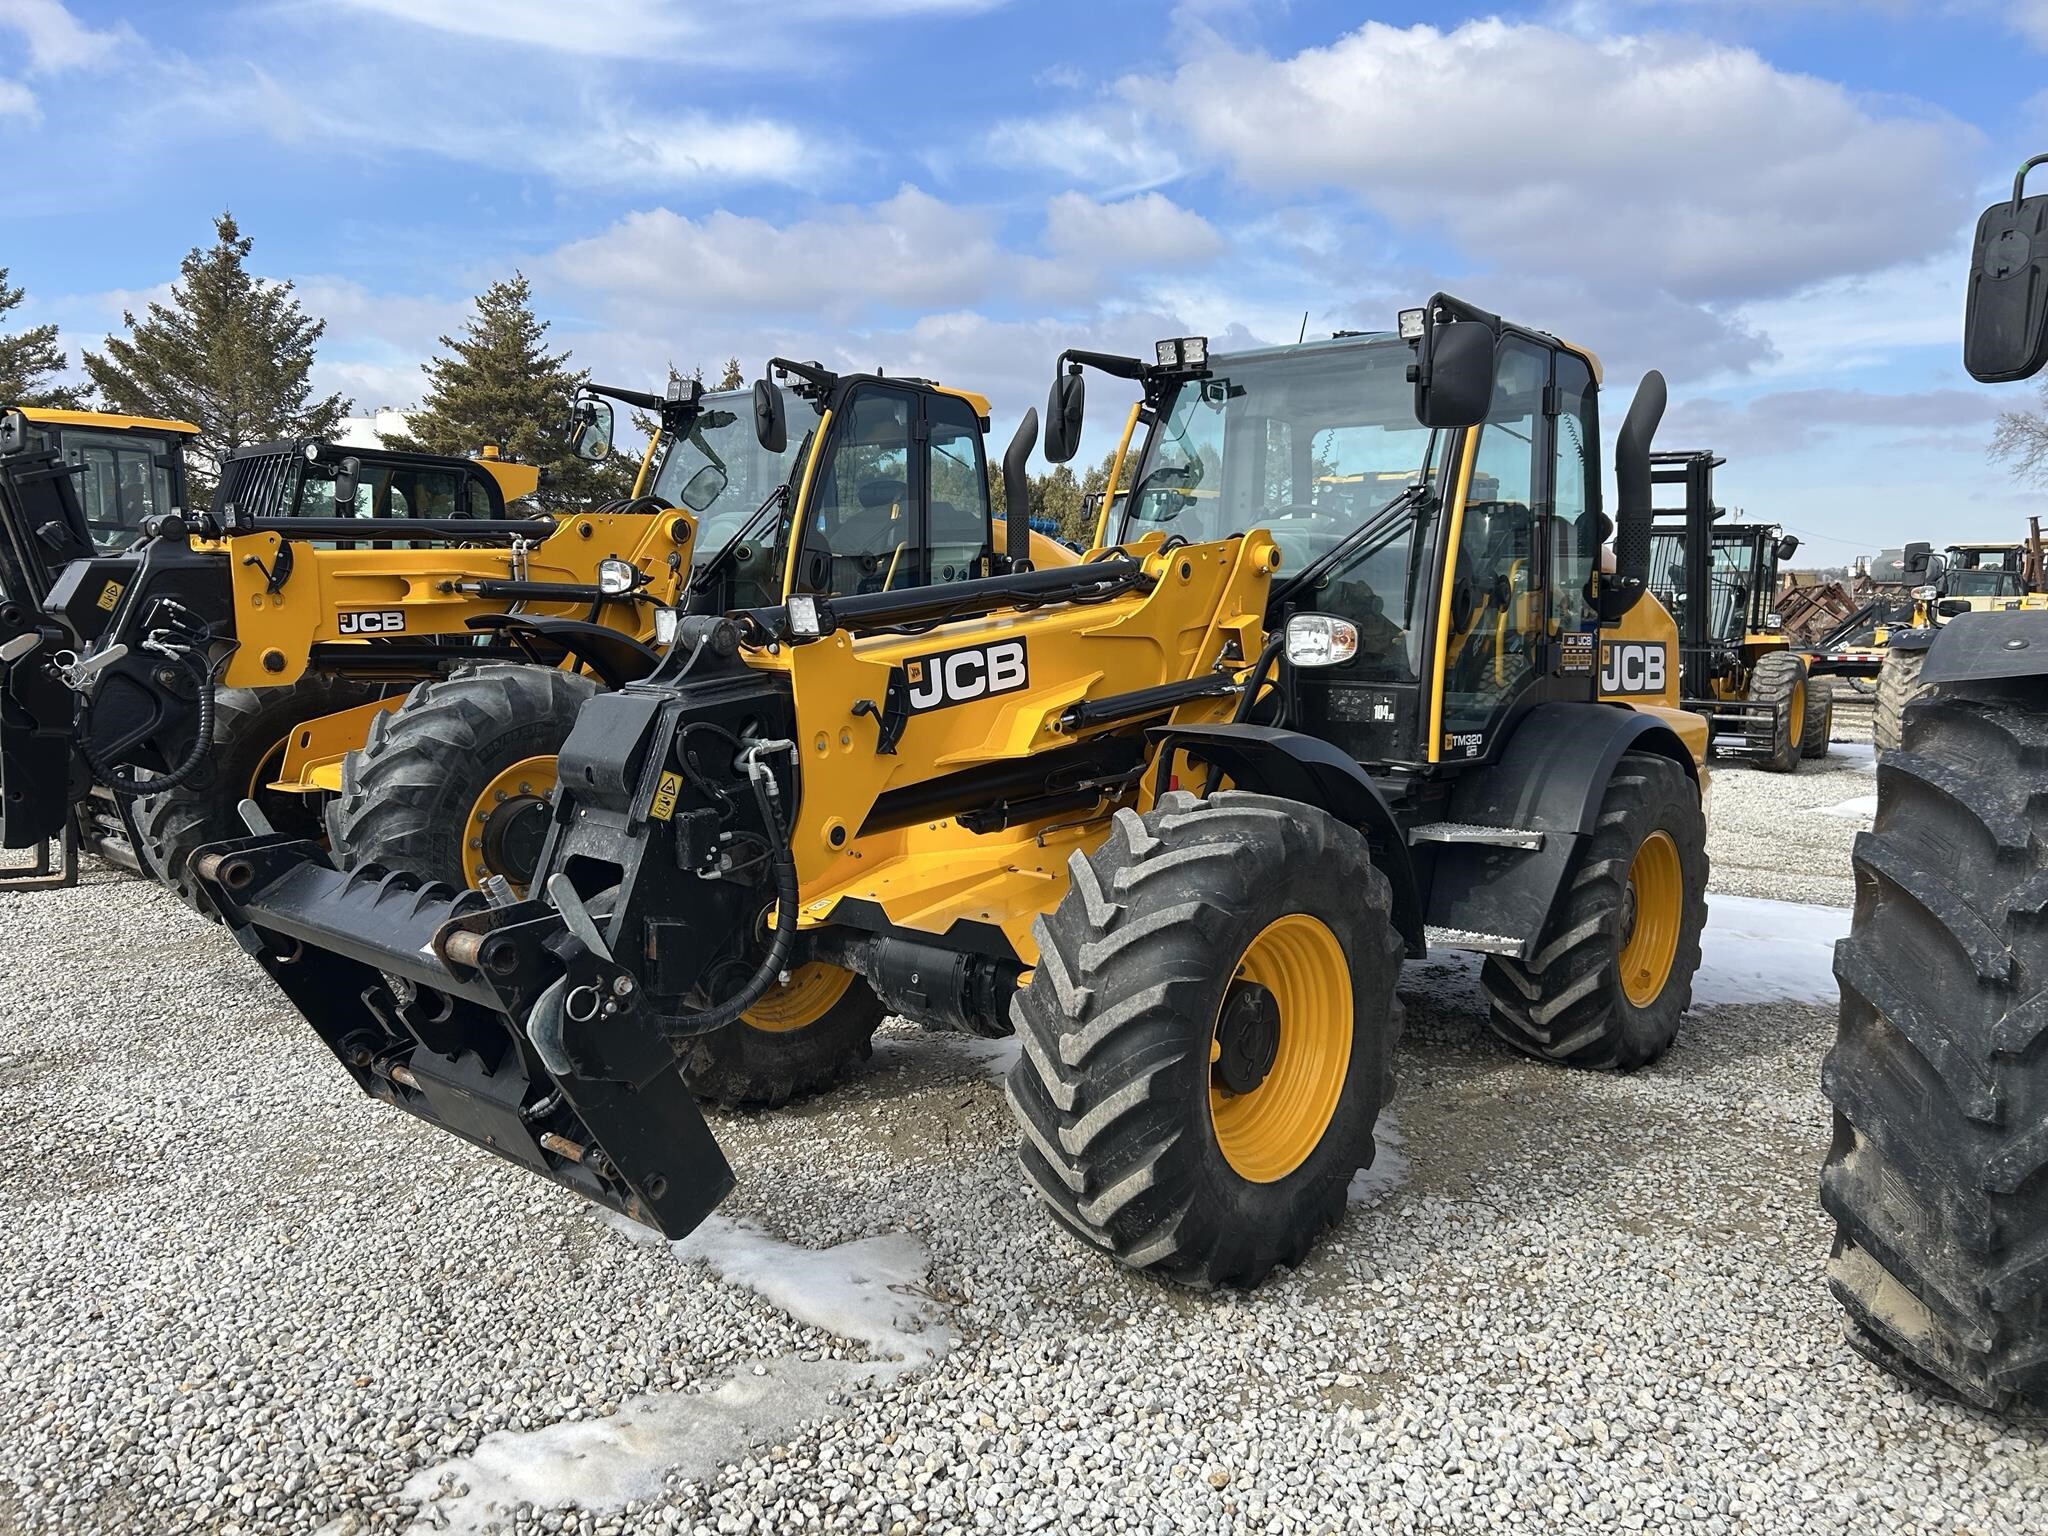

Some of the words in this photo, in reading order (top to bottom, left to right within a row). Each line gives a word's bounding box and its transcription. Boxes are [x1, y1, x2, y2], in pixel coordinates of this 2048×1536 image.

[340, 612, 404, 633] JCB
[910, 642, 1027, 709] JCB
[1601, 645, 1666, 692] JCB
[1452, 733, 1483, 747] TM320
